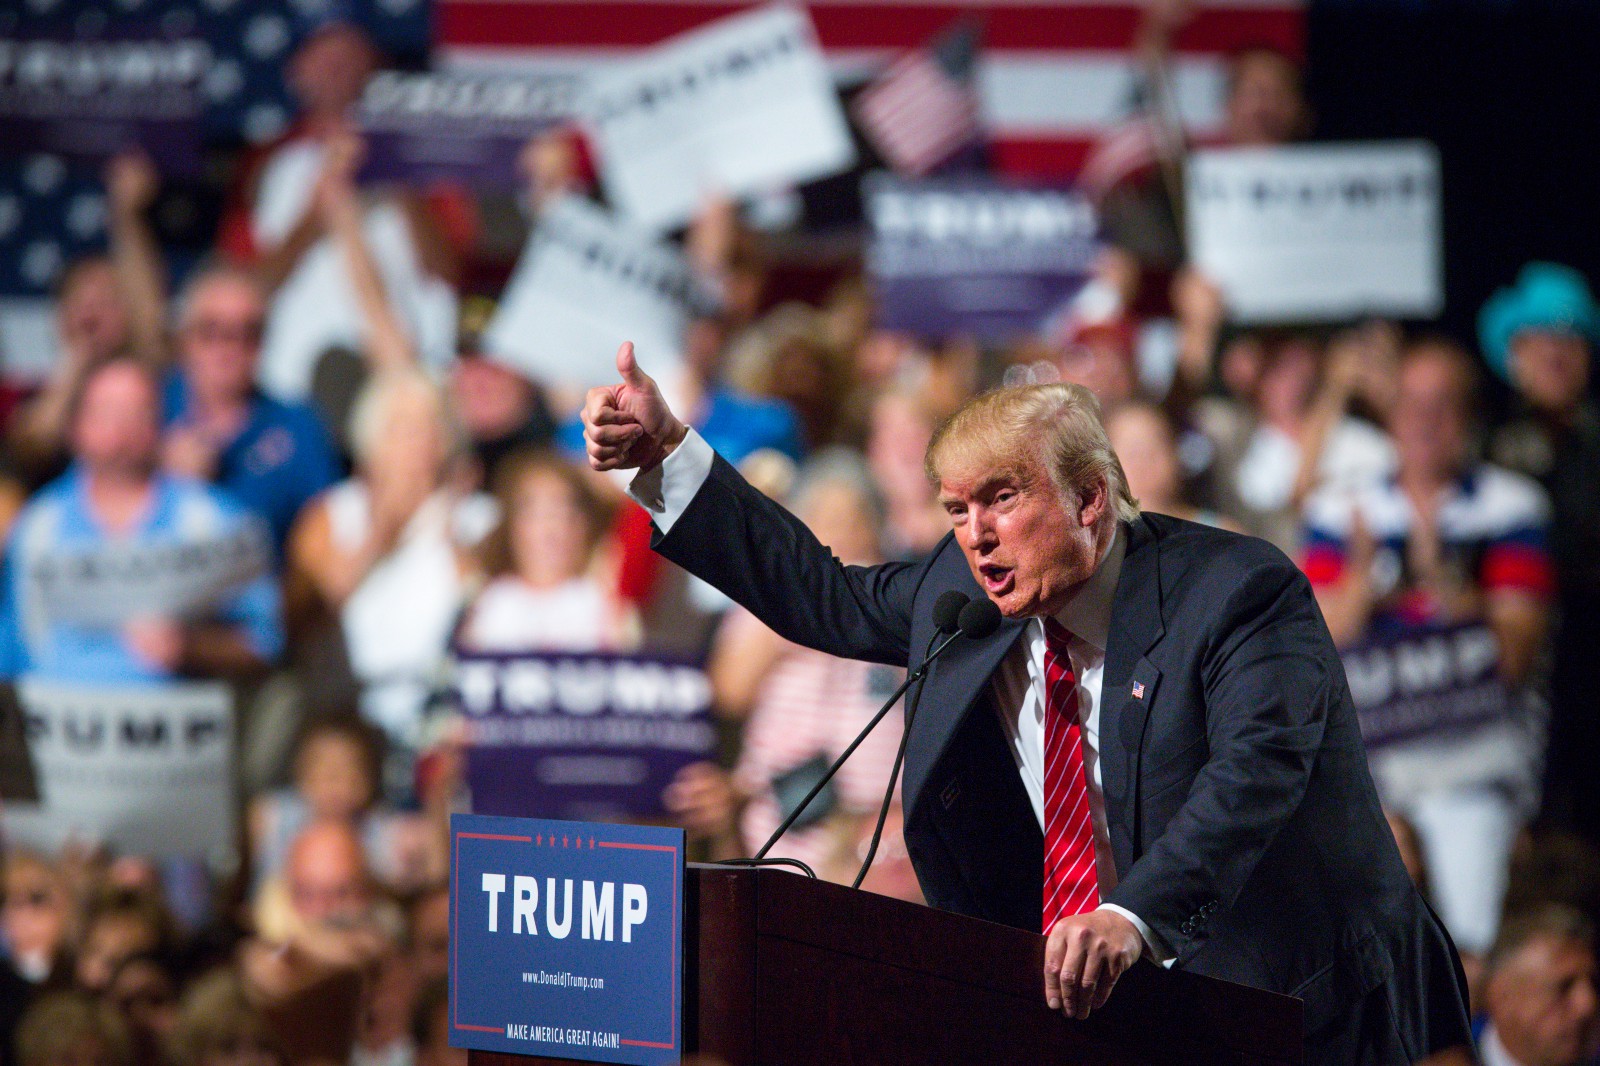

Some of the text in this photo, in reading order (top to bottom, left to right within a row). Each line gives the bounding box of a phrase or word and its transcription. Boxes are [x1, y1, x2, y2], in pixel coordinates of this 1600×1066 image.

[460, 658, 713, 717] TRUMP
[1342, 627, 1498, 707] UMP
[482, 873, 648, 943] TRUMP
[522, 970, 604, 991] www.DonaldJTrump.com
[506, 1023, 620, 1049] MAKE AMERICA GREAT AGAIN!
